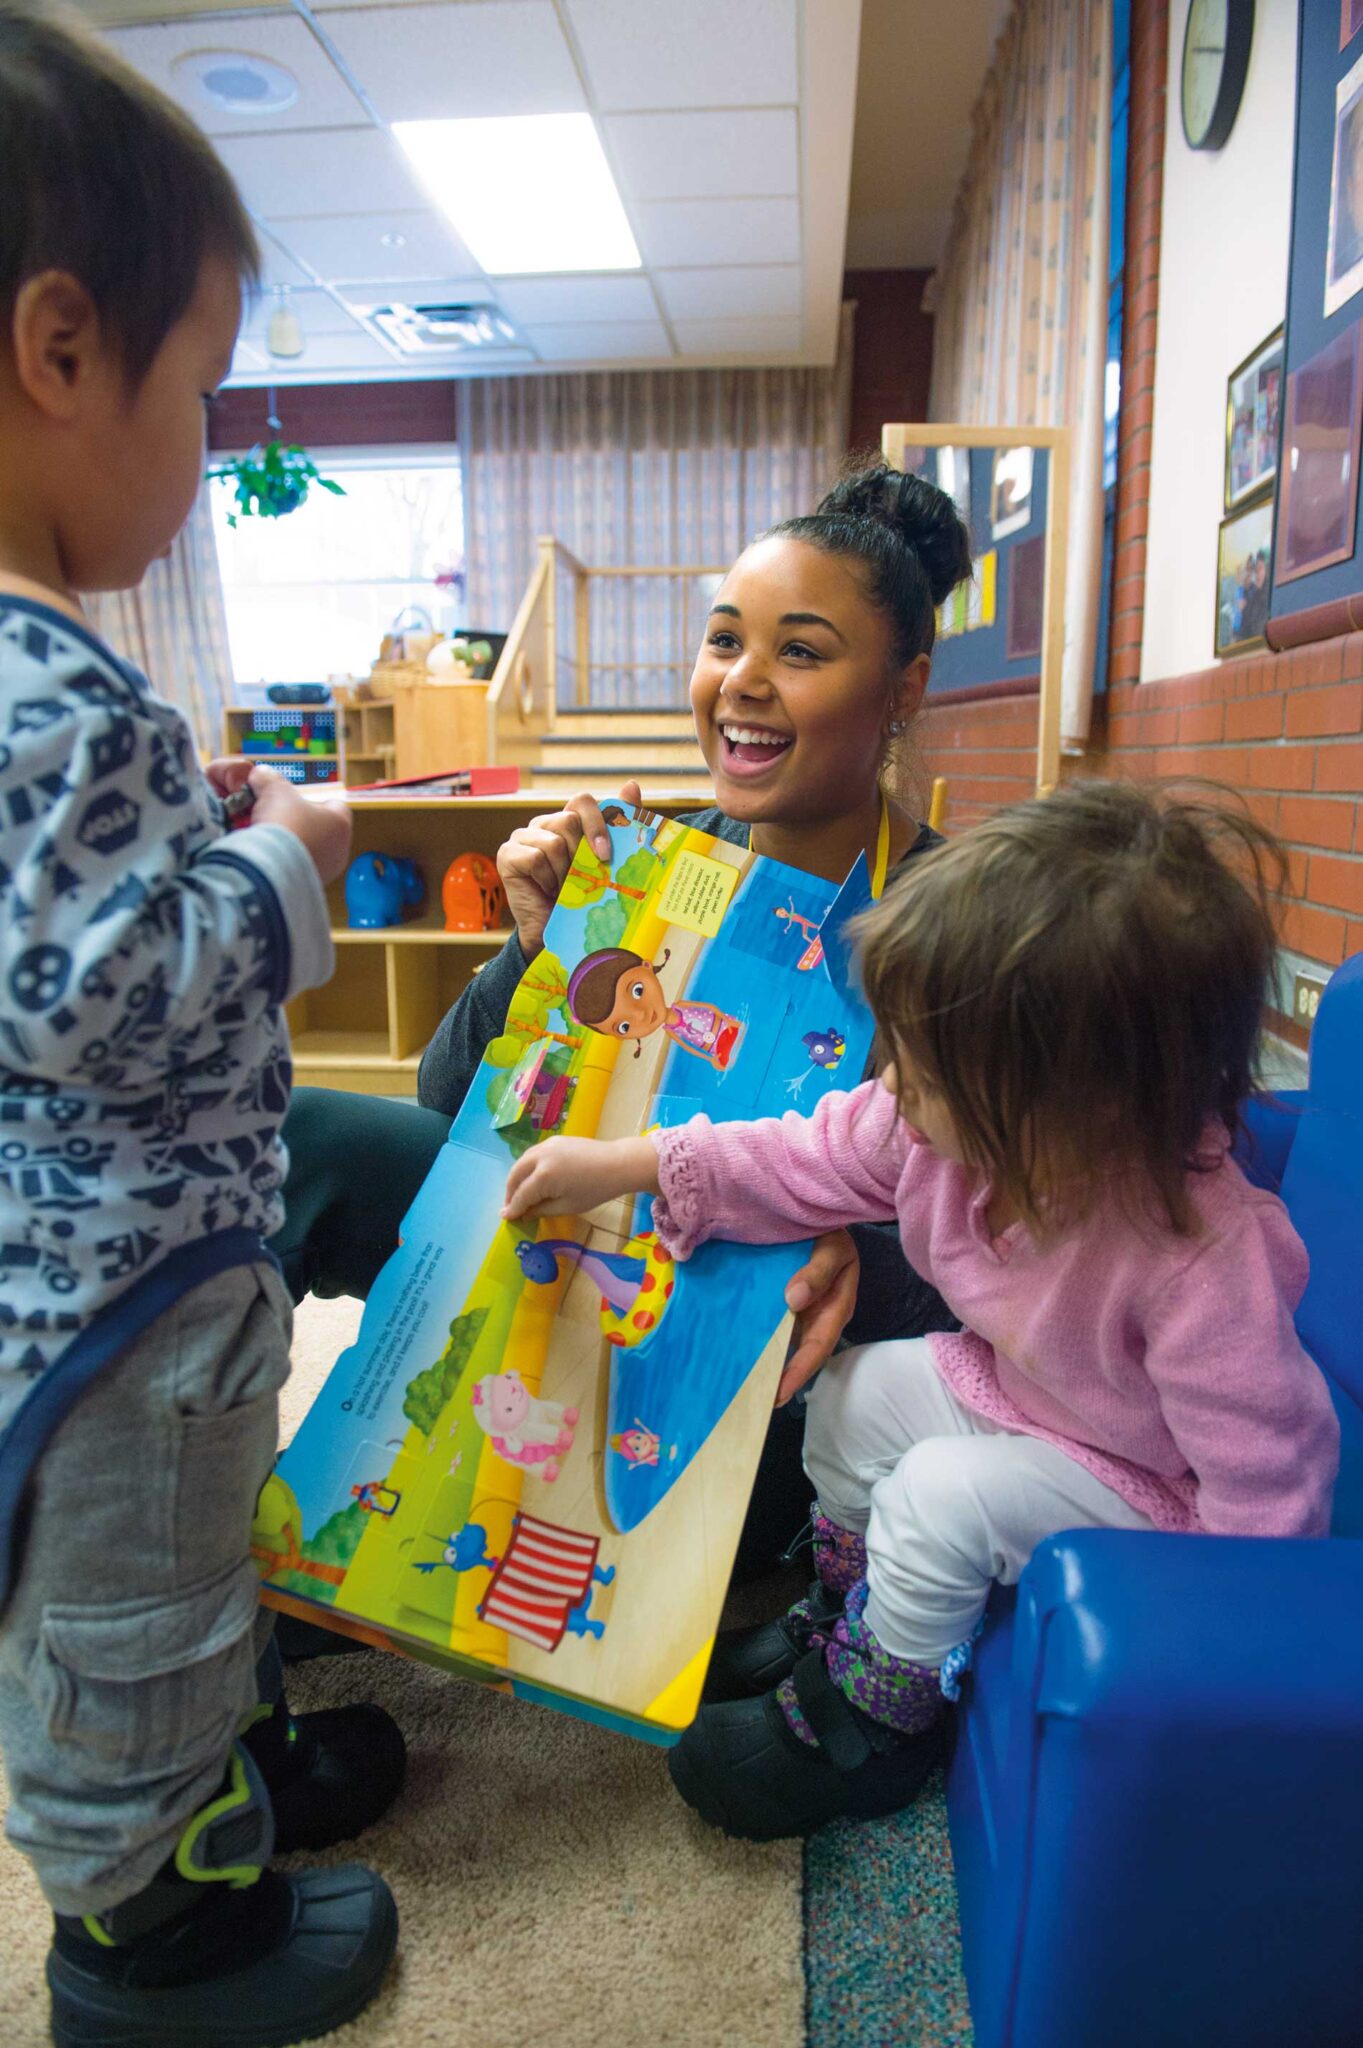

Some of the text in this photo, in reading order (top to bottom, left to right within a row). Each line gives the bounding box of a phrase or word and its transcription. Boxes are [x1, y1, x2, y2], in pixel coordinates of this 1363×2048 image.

[356, 1380, 380, 1416] splashing
[375, 1363, 386, 1378] and
[382, 1336, 401, 1363] playing
[399, 1315, 409, 1326] the
[424, 1261, 436, 1280] great
[433, 1246, 444, 1260] way
[362, 1344, 382, 1375] summer
[398, 1278, 417, 1304] nothing
[410, 1258, 425, 1277] better
[421, 1242, 433, 1256] than
[389, 1361, 400, 1376] and
[398, 1334, 414, 1354] keeps
[411, 1319, 421, 1332] you
